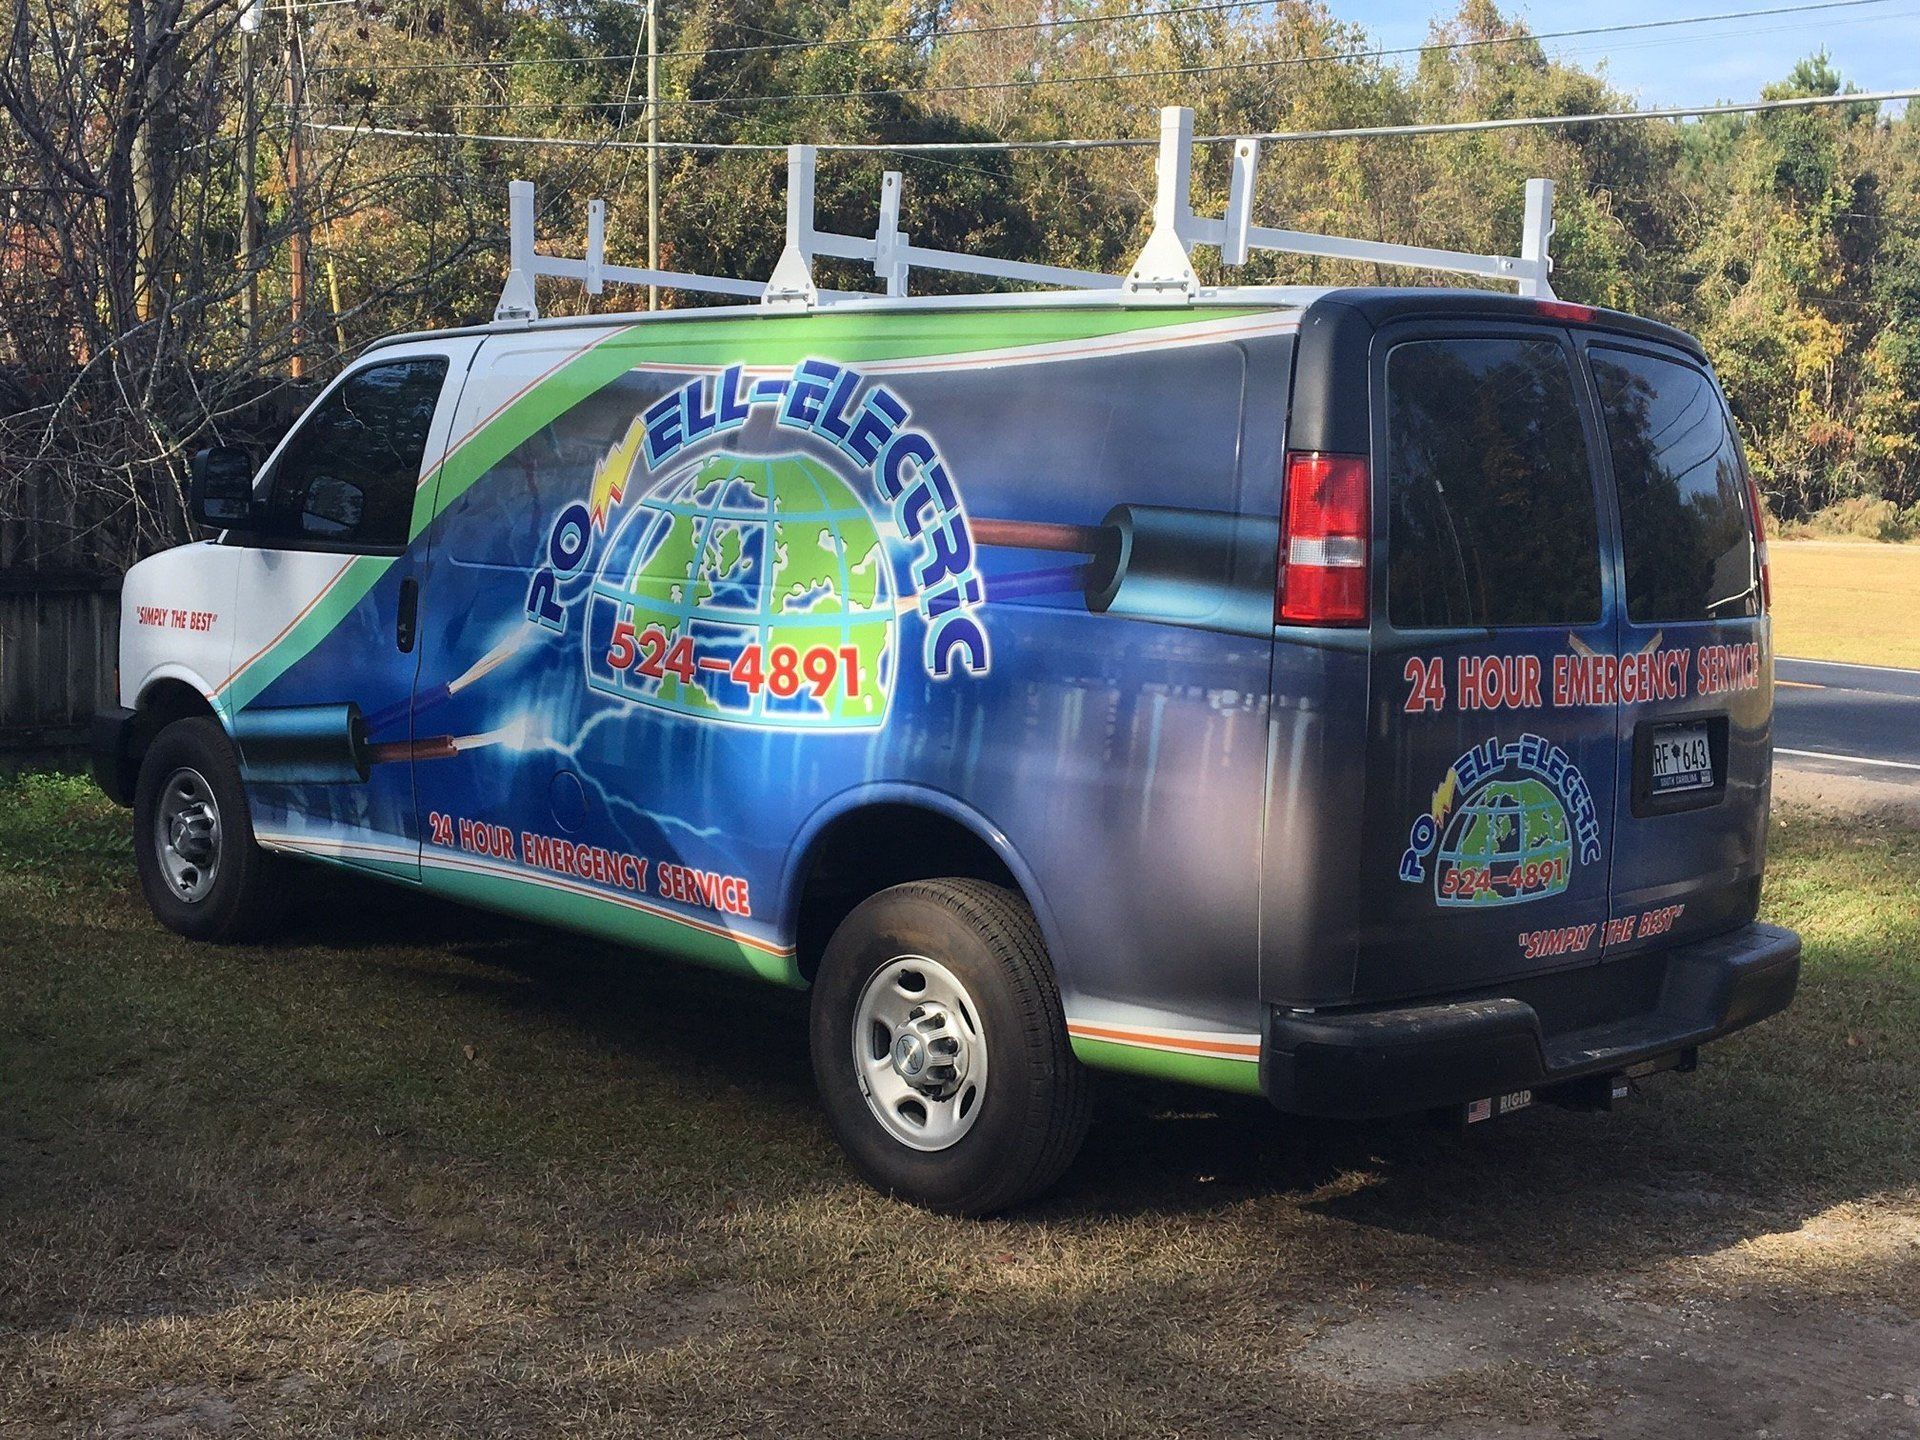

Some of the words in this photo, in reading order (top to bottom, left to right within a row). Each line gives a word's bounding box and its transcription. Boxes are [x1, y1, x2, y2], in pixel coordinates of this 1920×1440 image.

[171, 609, 188, 629] THE
[606, 623, 861, 698] 524-4891
[1404, 656, 1445, 712] 24
[1458, 655, 1542, 710] HOUR
[1553, 648, 1690, 707] EMERGENCY
[1697, 642, 1759, 696] SERVICE
[1683, 739, 1707, 771] 643
[429, 811, 454, 846] 24
[458, 817, 517, 861] HOUR
[521, 831, 649, 892] EMERGENCY
[658, 861, 751, 916] SERVICE
[1441, 857, 1563, 895] 524-4891
[1600, 918, 1636, 948] THE
